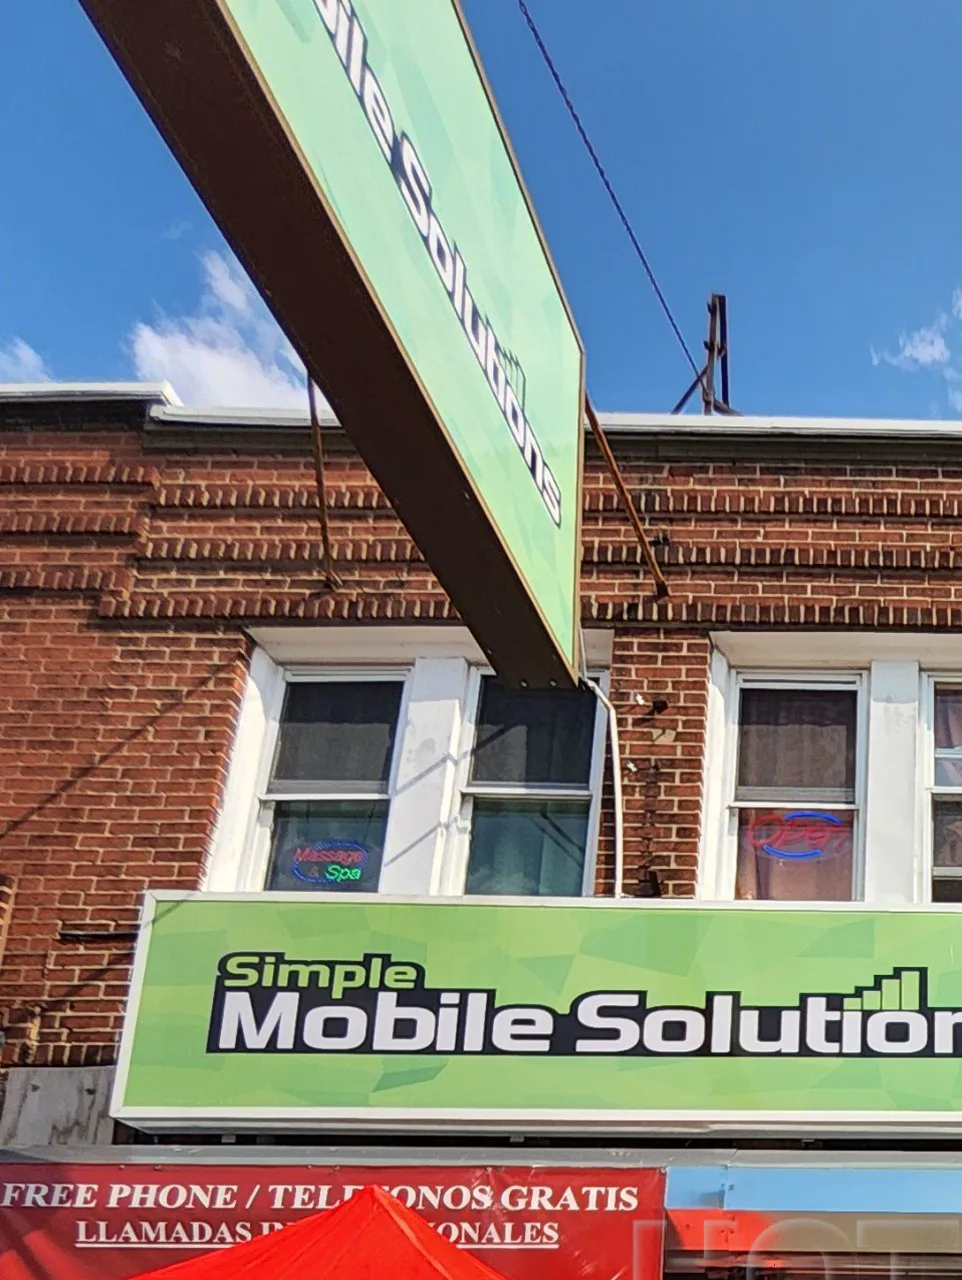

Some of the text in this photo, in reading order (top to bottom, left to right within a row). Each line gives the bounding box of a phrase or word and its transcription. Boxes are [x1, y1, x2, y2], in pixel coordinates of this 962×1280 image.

[399, 131, 562, 528] Solutions
[294, 847, 364, 865] Massage
[324, 863, 362, 883] Spa
[223, 956, 418, 999] Simple
[218, 991, 555, 1052] Mobile
[1, 1183, 640, 1212] FREE PHONE / TELONOS GRATIS
[75, 1220, 252, 1243] LLAMADAS
